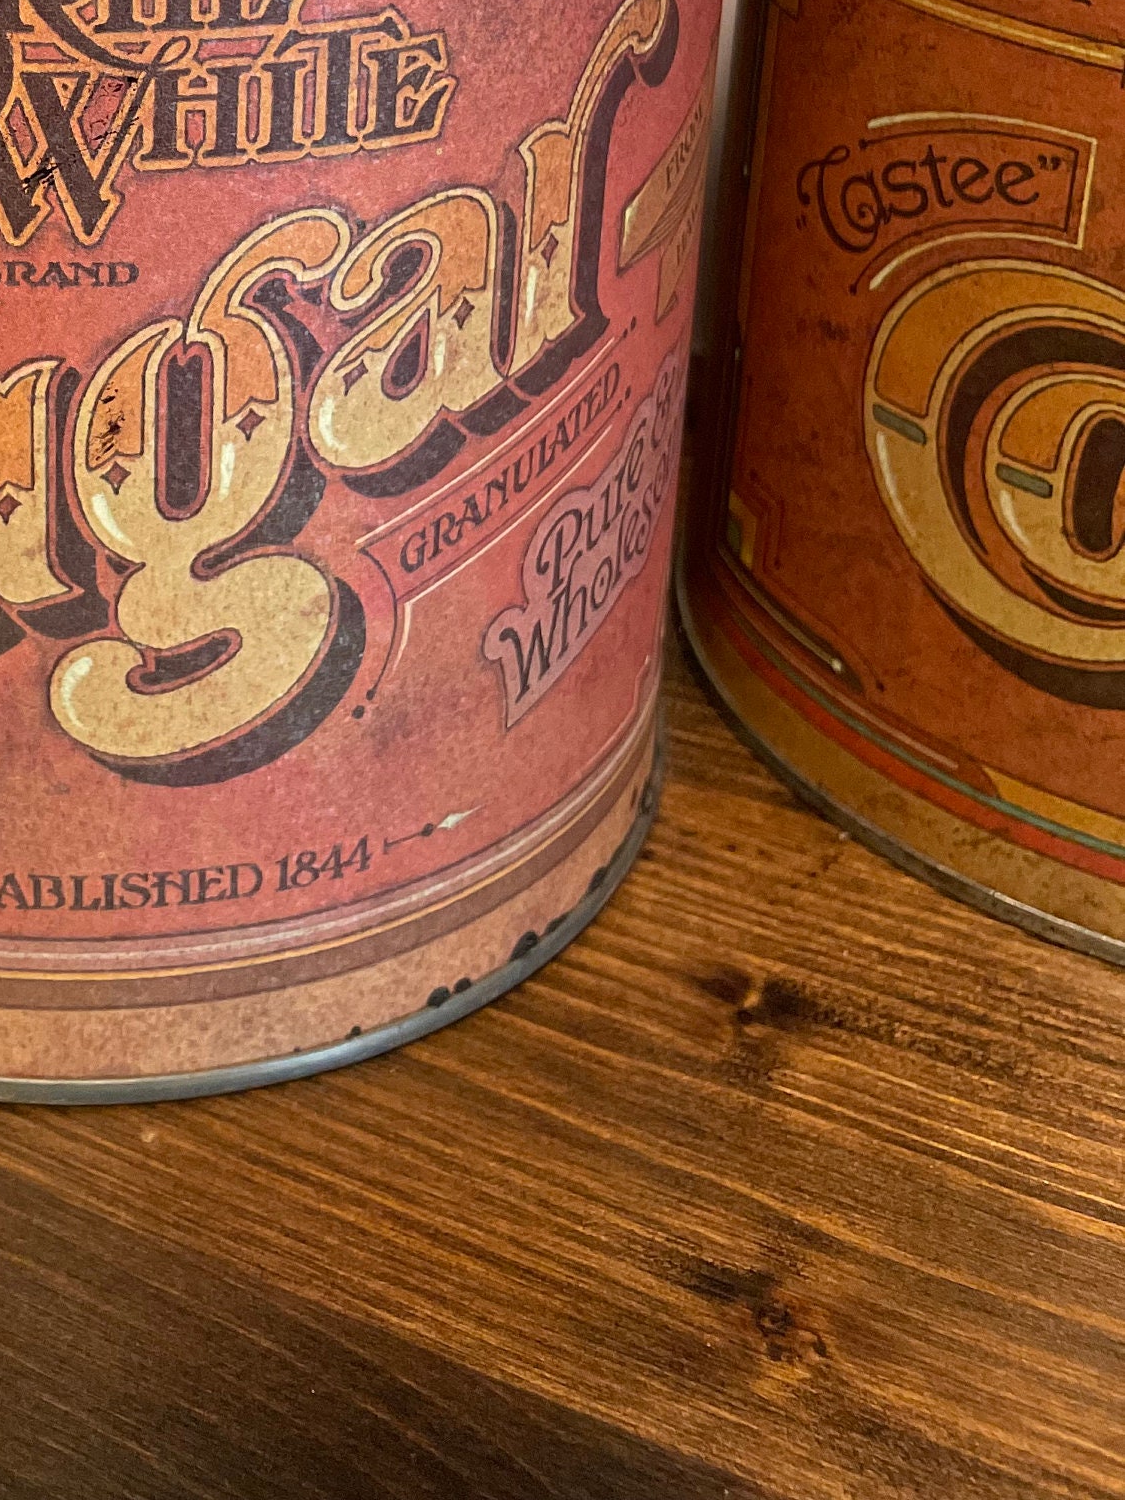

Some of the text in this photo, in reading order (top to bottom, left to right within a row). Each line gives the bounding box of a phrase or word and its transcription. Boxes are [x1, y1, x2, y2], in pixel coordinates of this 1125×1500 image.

[398, 361, 621, 574] GRANULATED
[536, 416, 648, 597] Pure
[275, 834, 372, 893] 1844
